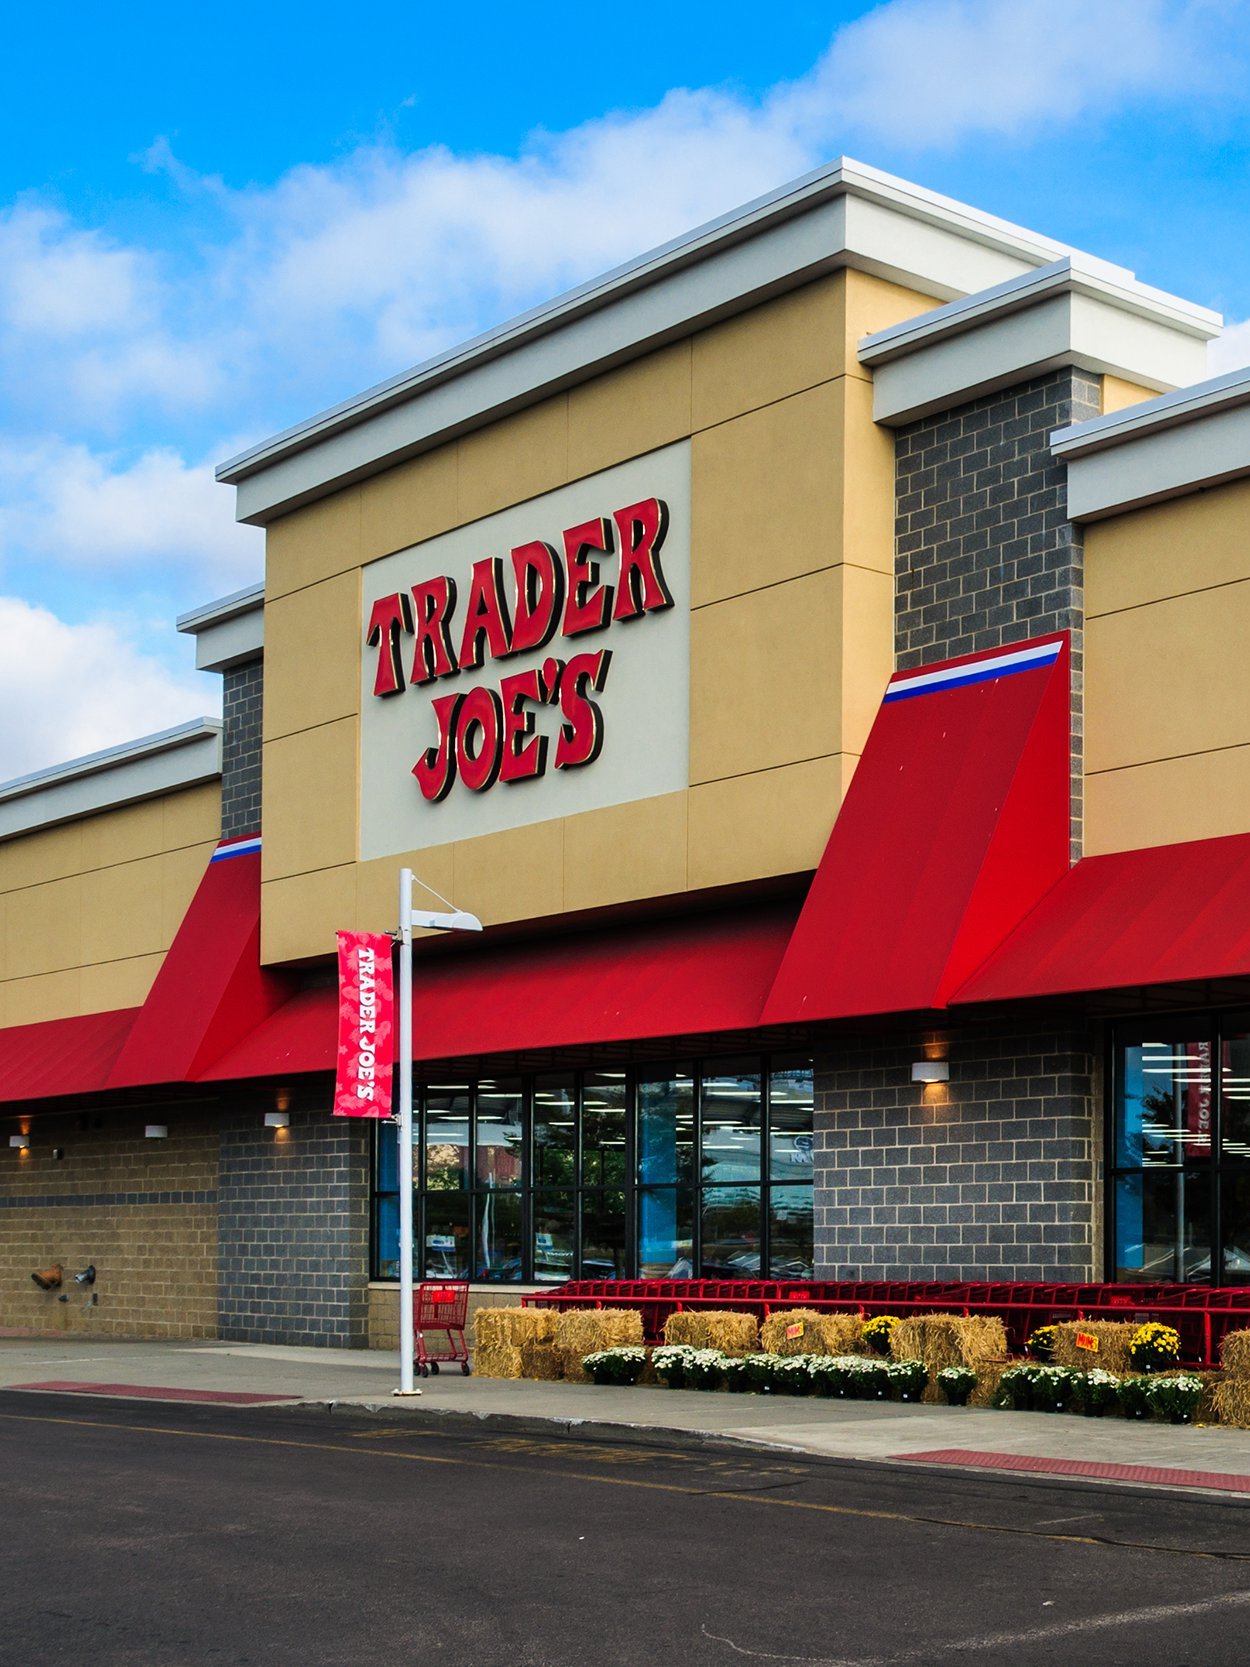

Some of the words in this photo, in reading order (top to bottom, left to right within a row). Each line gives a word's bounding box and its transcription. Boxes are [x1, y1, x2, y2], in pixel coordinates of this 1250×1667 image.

[366, 497, 675, 697] TRADER
[411, 649, 613, 801] JOE'S
[357, 947, 376, 1034] TRADER
[356, 1035, 376, 1101] JOE'S
